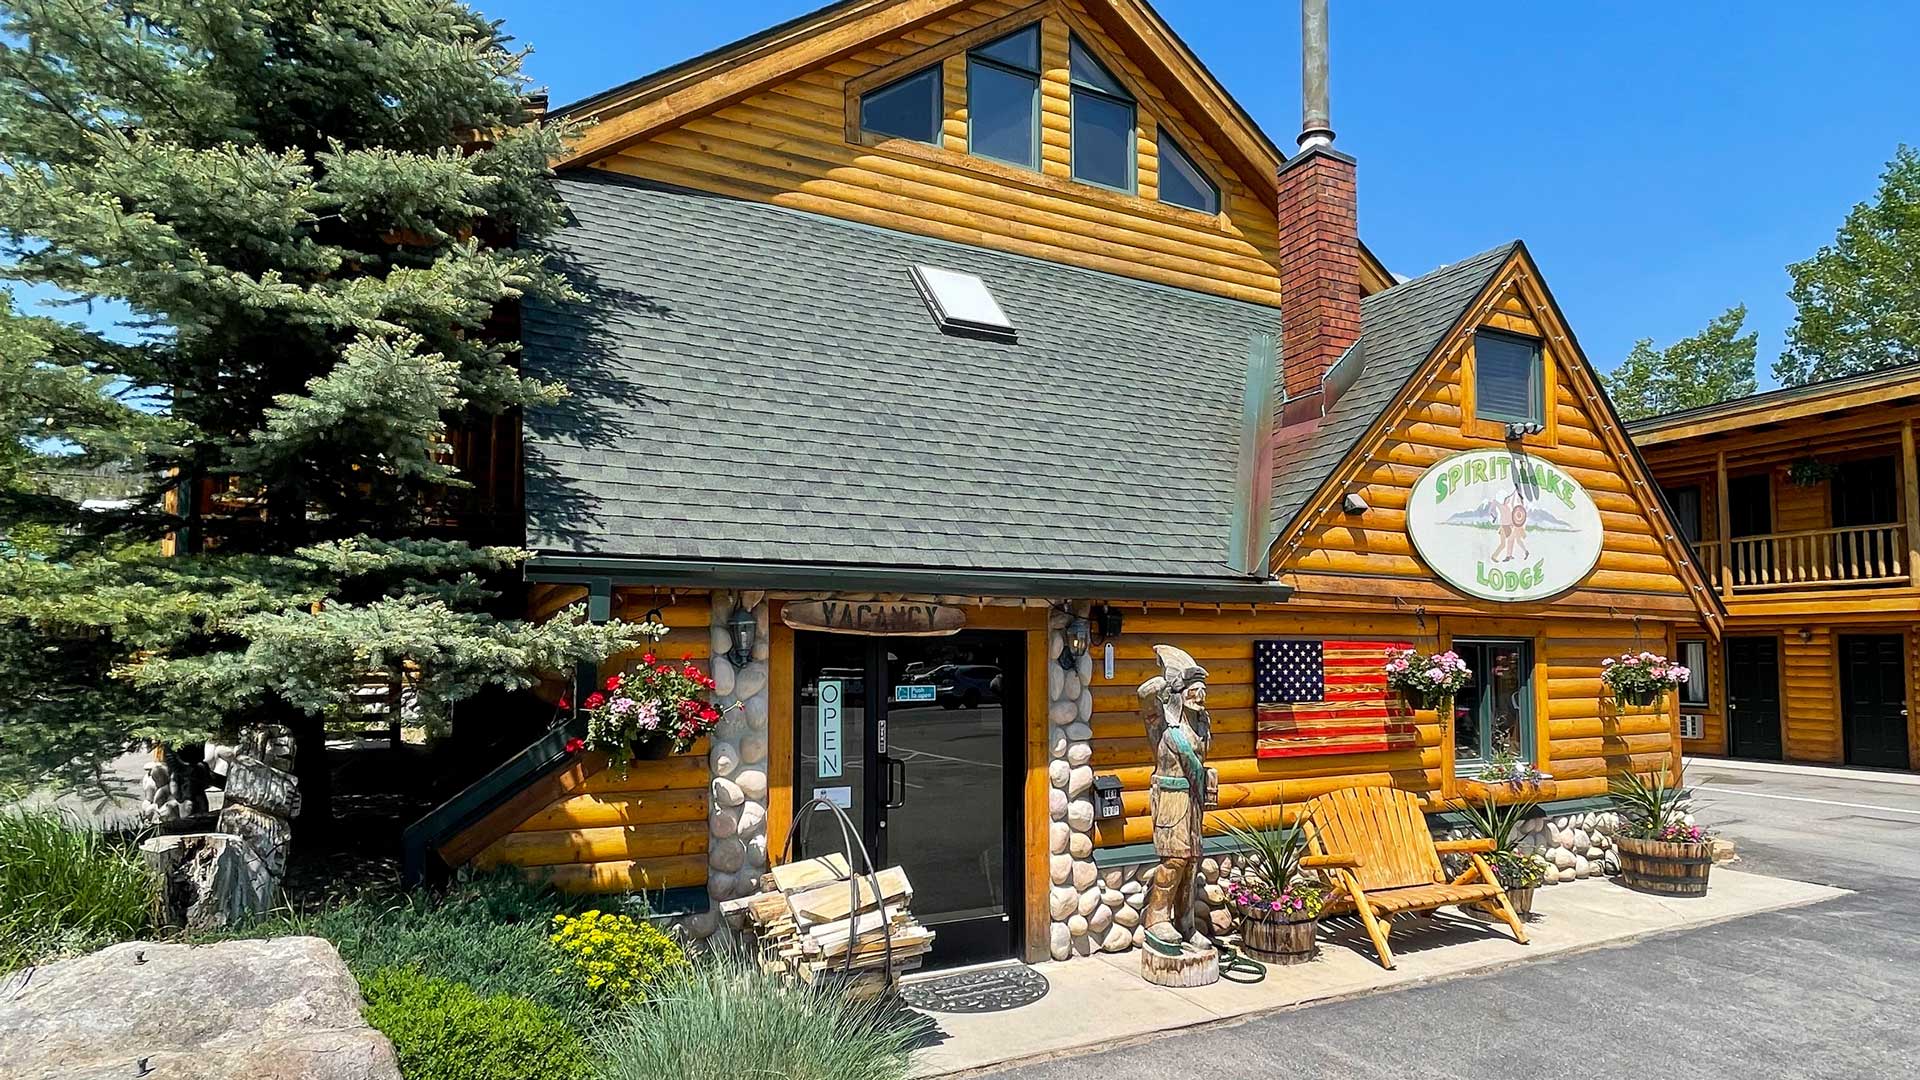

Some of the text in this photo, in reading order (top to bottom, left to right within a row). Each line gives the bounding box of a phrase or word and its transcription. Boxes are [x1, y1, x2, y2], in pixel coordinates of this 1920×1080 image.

[1435, 456, 1511, 504] SPIRIT
[1476, 557, 1545, 592] LODGE
[822, 602, 938, 630] VACANCY
[822, 684, 838, 775] OPEN
